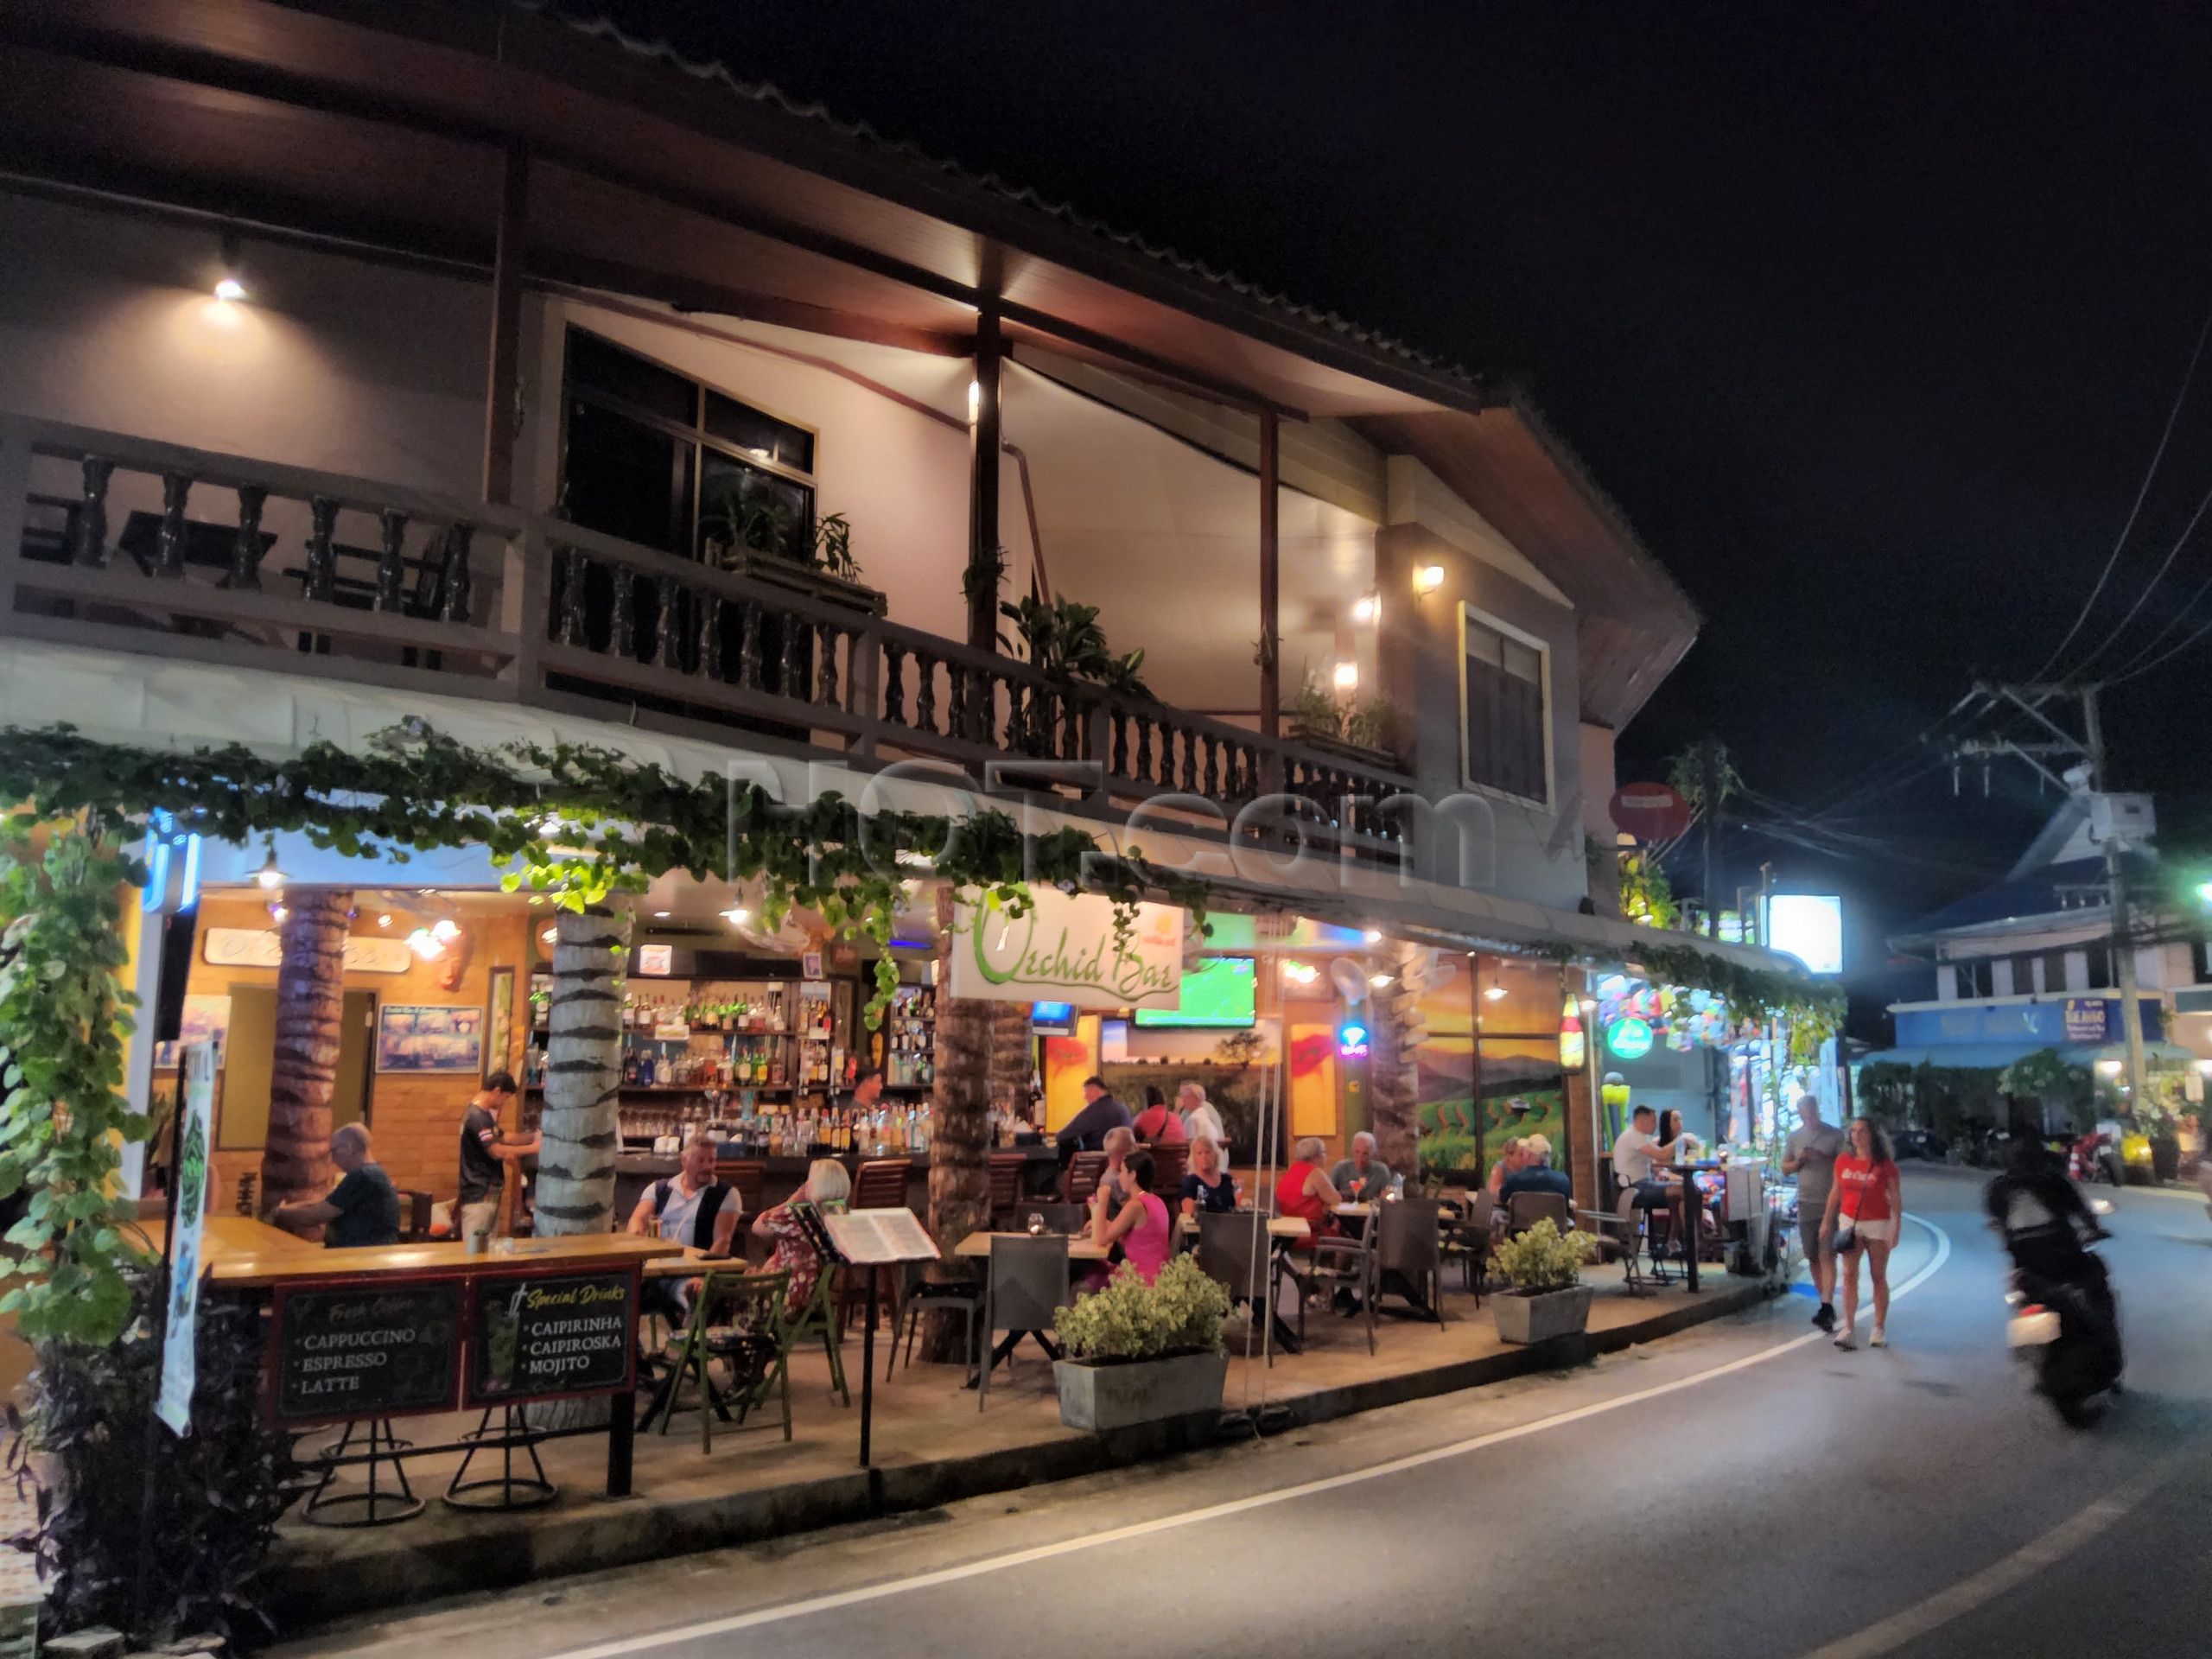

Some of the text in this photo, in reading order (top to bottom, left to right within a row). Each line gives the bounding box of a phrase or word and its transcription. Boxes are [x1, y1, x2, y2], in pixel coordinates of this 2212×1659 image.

[973, 883, 1172, 994] Orchid Bar
[526, 1284, 626, 1311] Special Drinks
[531, 1316, 622, 1337] CAIPIRINHA
[304, 1328, 416, 1351] CAPPUCCINO
[530, 1335, 621, 1356] CAIPIROSKA
[302, 1351, 387, 1372] ESPRESSO
[529, 1355, 590, 1376] MOJITO
[301, 1376, 359, 1395] LATTE
